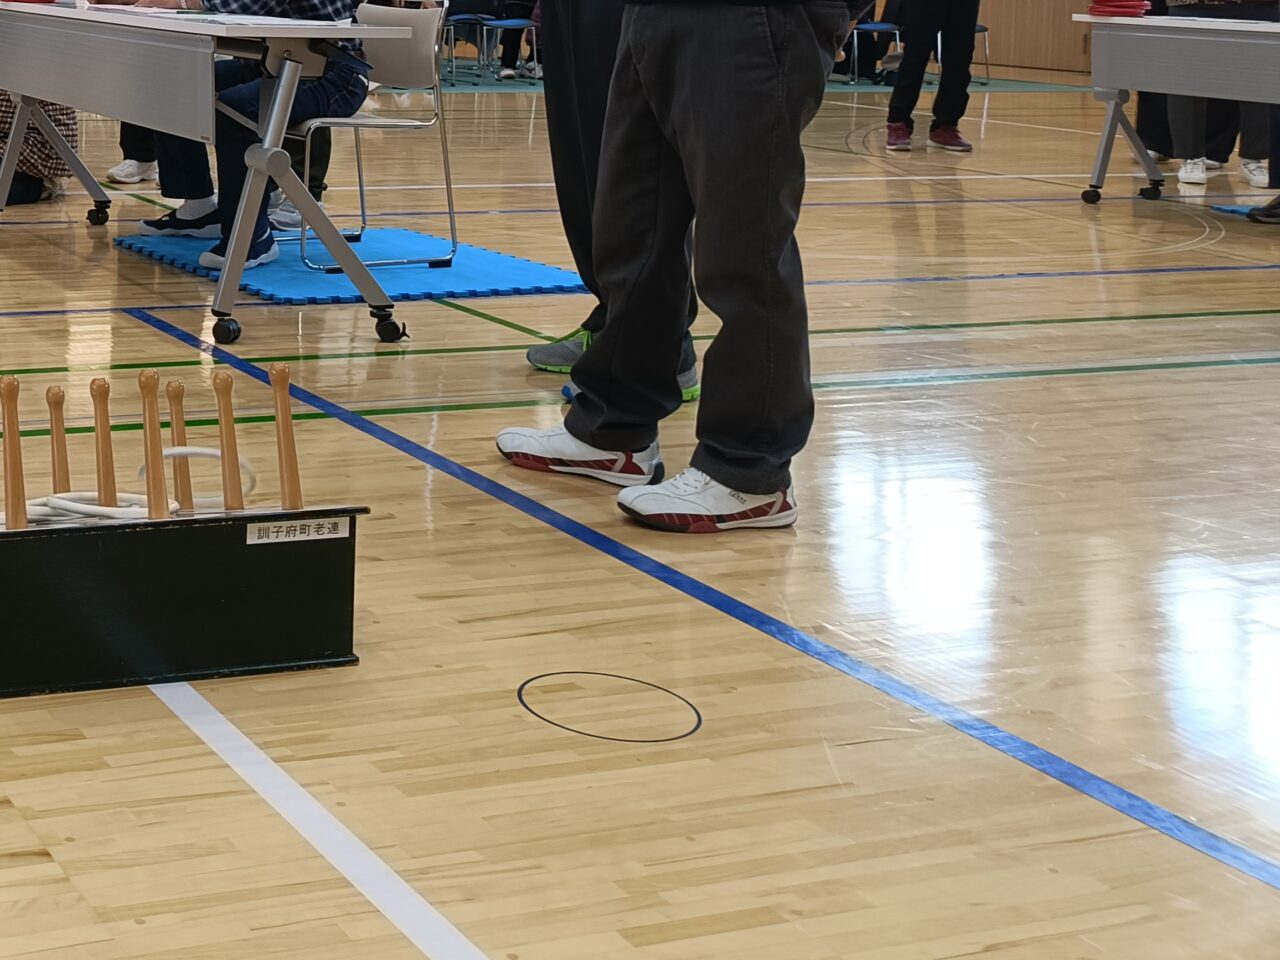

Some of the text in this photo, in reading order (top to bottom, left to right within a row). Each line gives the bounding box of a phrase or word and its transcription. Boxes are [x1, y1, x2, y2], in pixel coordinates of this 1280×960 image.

[257, 521, 340, 540] 訓子府町老連
